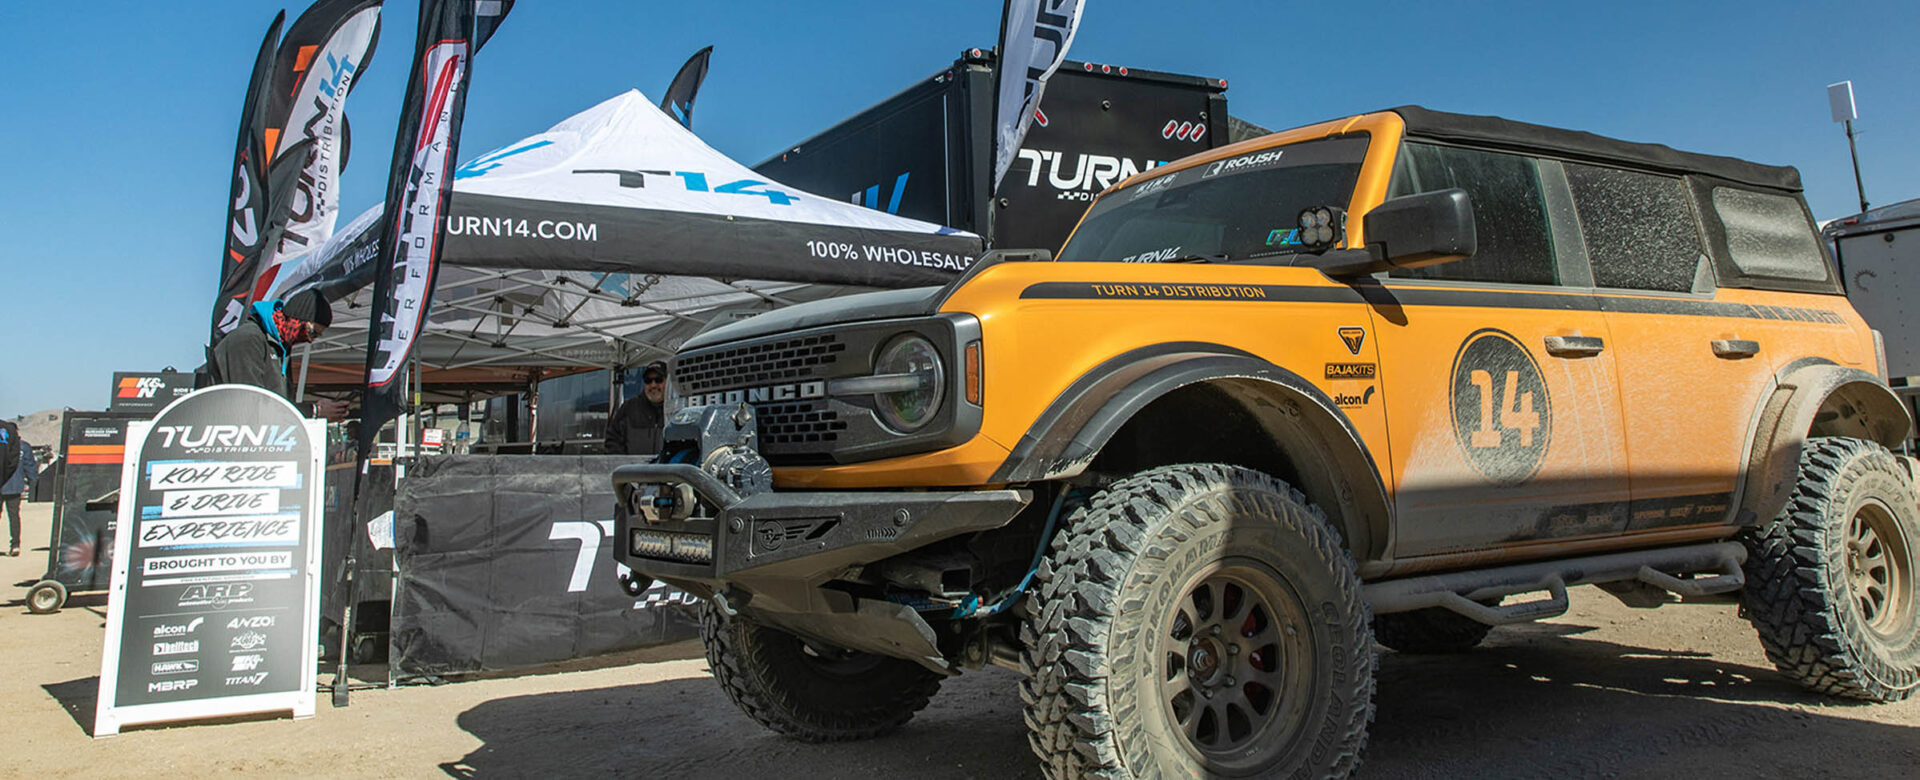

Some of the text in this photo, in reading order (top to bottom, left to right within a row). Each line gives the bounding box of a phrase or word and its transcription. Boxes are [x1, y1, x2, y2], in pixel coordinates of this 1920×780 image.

[319, 74, 351, 193] DISTRIBUTION
[1224, 150, 1284, 169] ROUSH
[1018, 148, 1169, 191] TURN
[572, 170, 801, 206] T14
[447, 215, 598, 242] URN14.COM
[806, 240, 859, 261] 100%
[1091, 284, 1267, 299] TURN 14 DISTRIBUTION
[1327, 365, 1375, 375] BAJAKITS
[688, 381, 825, 407] BRONCO
[1334, 393, 1362, 405] alcon
[1471, 368, 1540, 449] 14
[157, 424, 299, 452] TURN14
[203, 446, 284, 454] DISTRIBUTION
[158, 465, 284, 485] KOH RIDE
[191, 493, 269, 511] DRIVE
[143, 519, 296, 542] EXPERIENCE
[149, 555, 287, 571] BROUGHT TO YOU BY
[180, 582, 254, 600] ARP
[153, 624, 187, 635] alcon
[148, 679, 199, 692] MBRP
